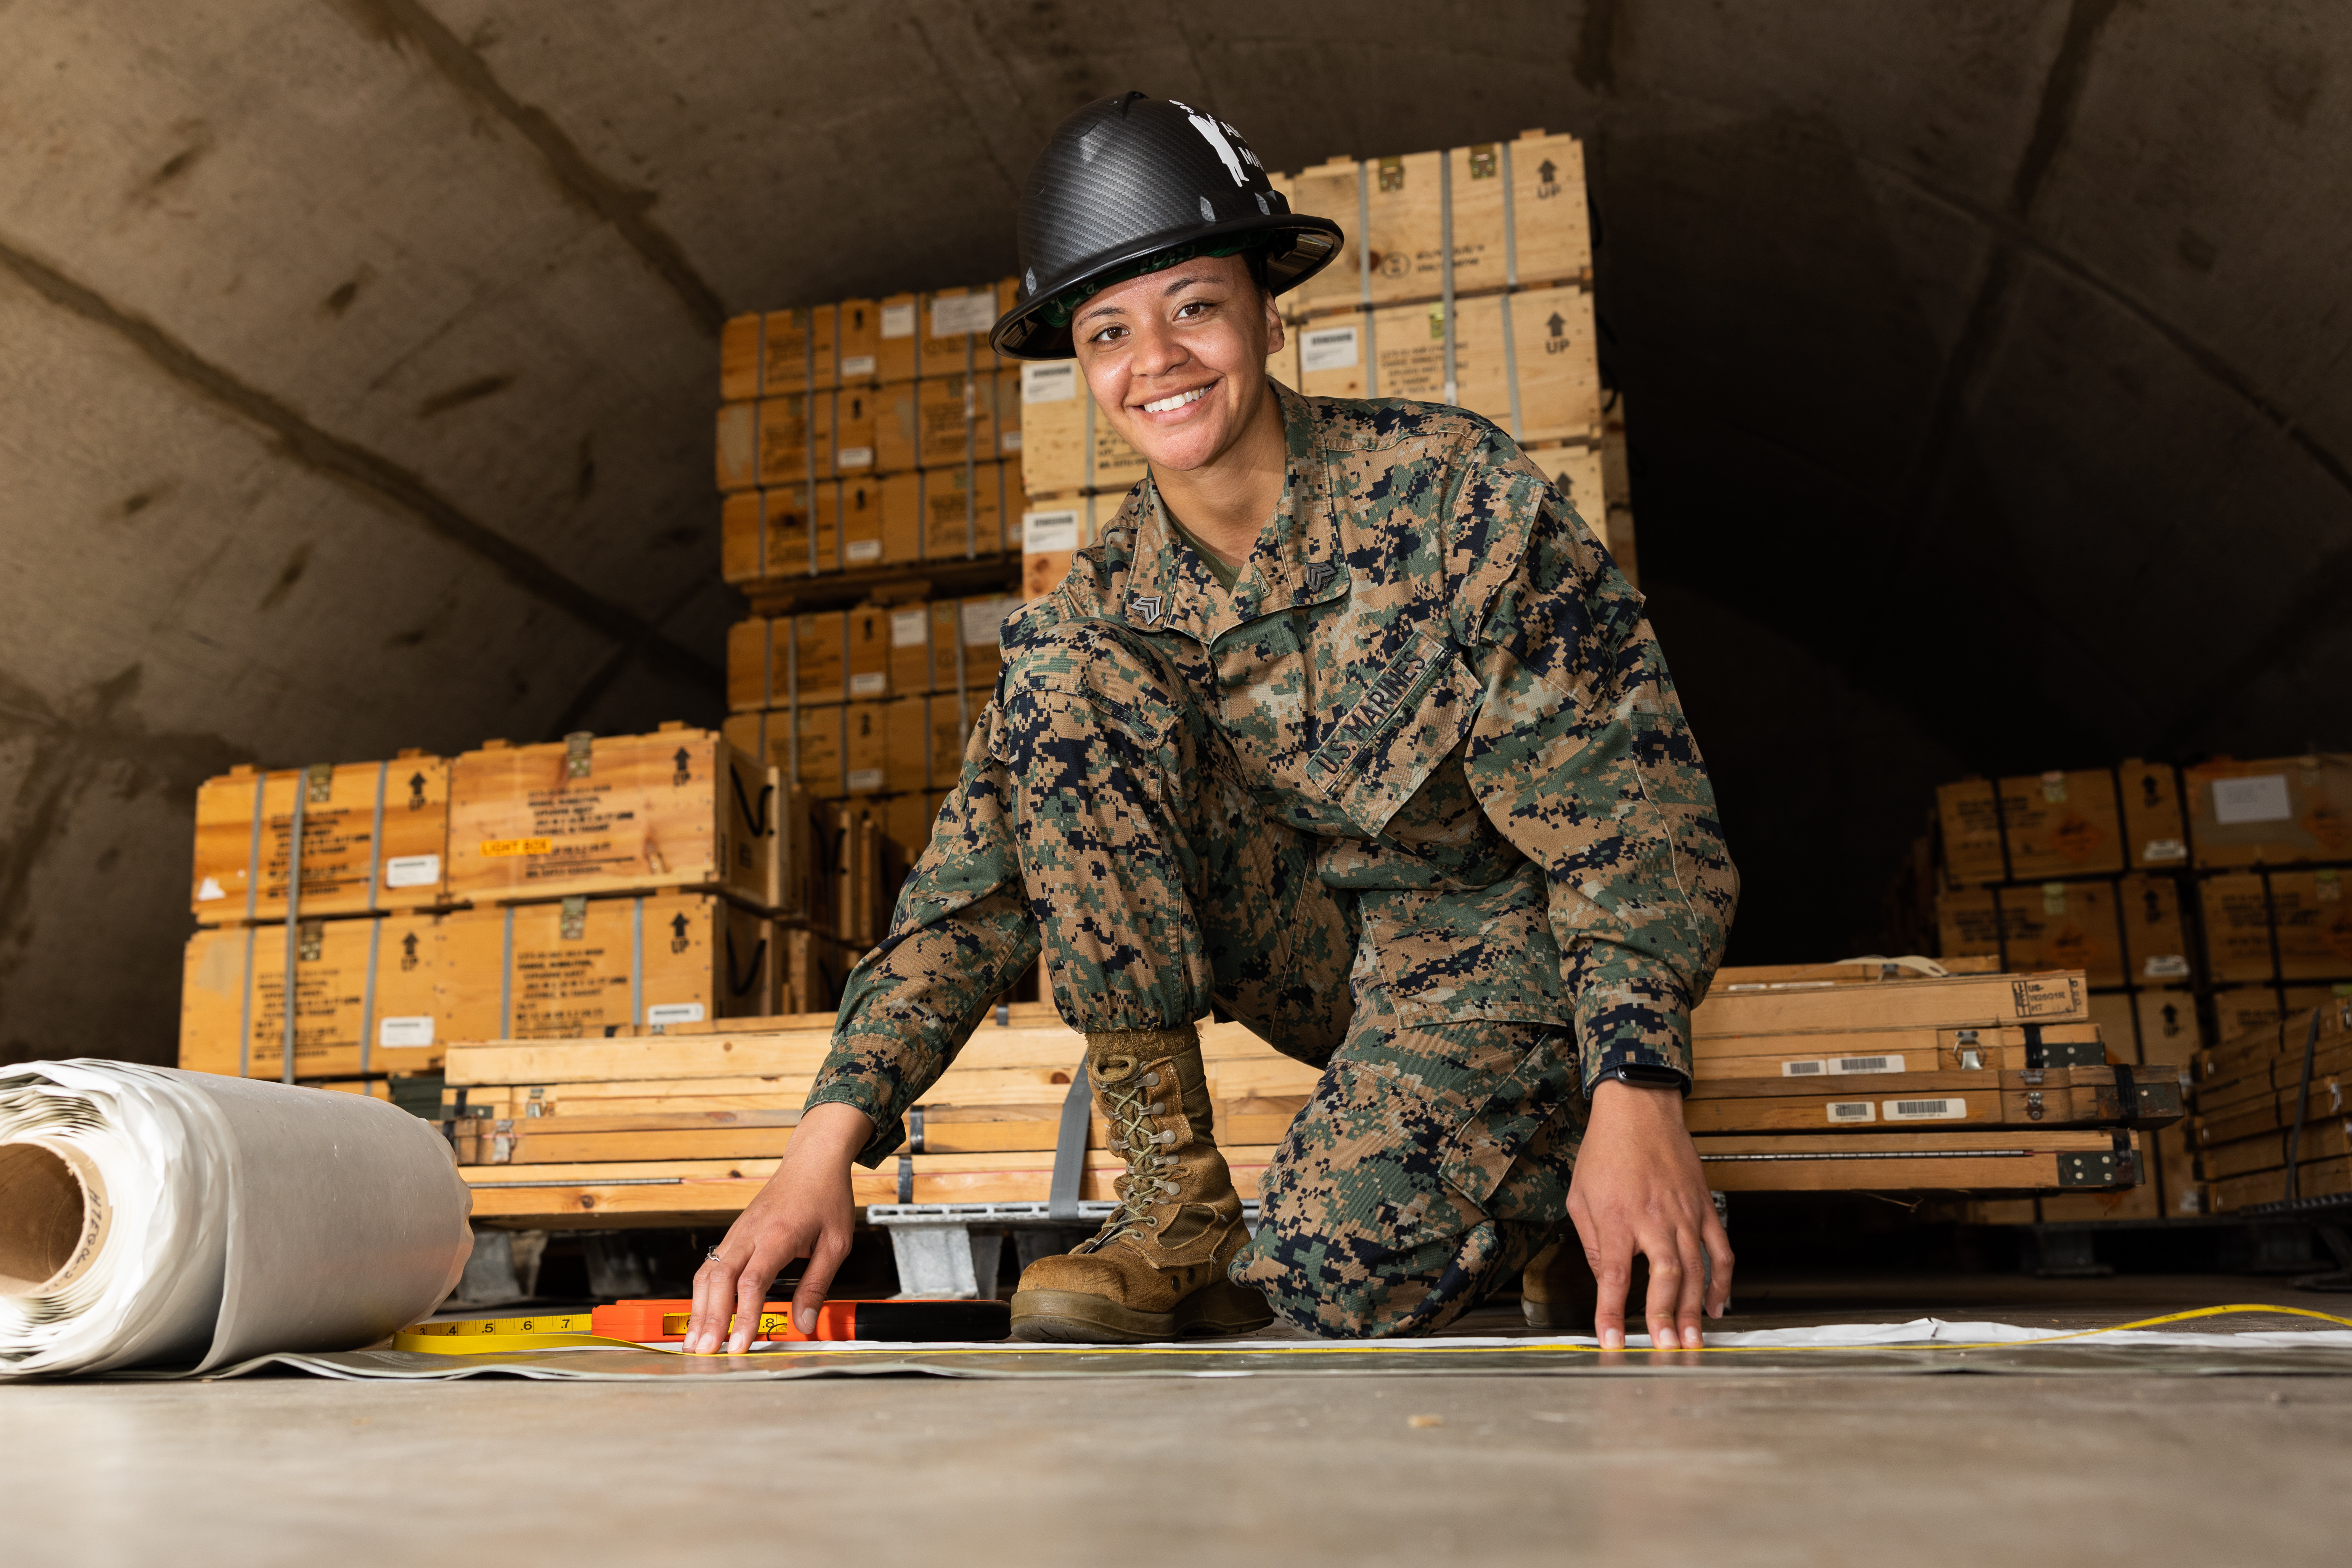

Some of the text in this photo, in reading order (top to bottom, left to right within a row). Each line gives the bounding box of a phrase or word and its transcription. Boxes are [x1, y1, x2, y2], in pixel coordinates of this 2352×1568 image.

[1537, 184, 1561, 199] UP
[1546, 338, 1570, 355] UP
[1315, 649, 1426, 774] U.S. MARINES
[672, 939, 689, 954] UP
[447, 1325, 457, 1336] .4
[482, 1323, 493, 1333] .5
[521, 1321, 532, 1331] .6
[561, 1319, 570, 1329] .7
[762, 1318, 775, 1329] .8
